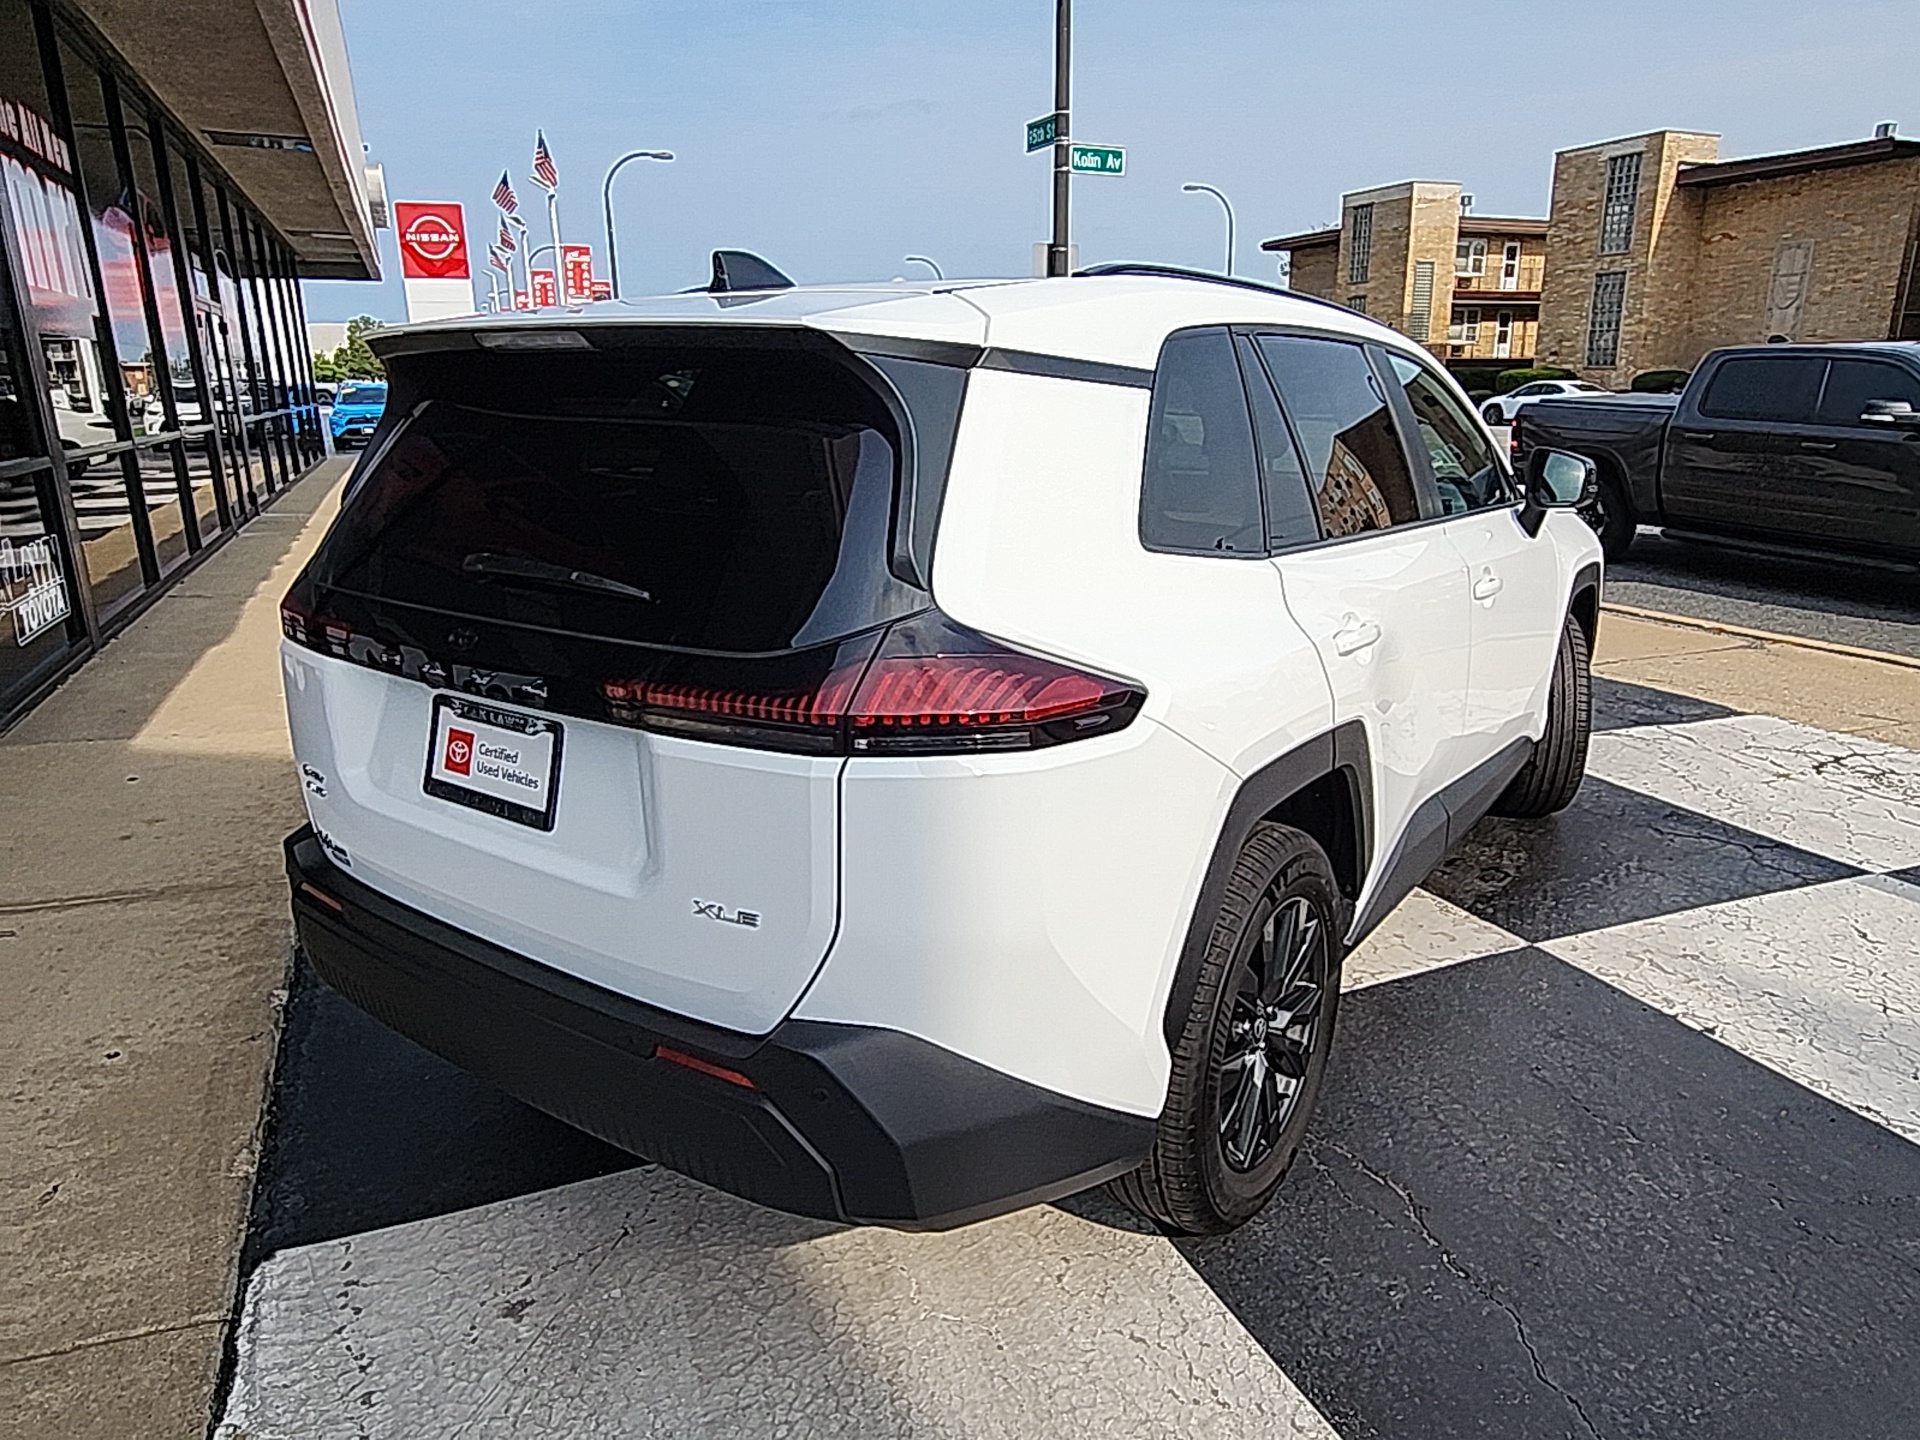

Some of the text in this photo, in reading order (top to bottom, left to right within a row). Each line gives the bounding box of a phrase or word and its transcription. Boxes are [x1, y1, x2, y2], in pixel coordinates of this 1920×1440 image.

[1073, 150, 1122, 170] Kolin Av
[405, 232, 460, 243] NISSAN
[18, 585, 65, 635] TOYOTA
[478, 743, 519, 764] Certified
[476, 760, 540, 789] Used Vehicles
[692, 899, 761, 929] XLE
